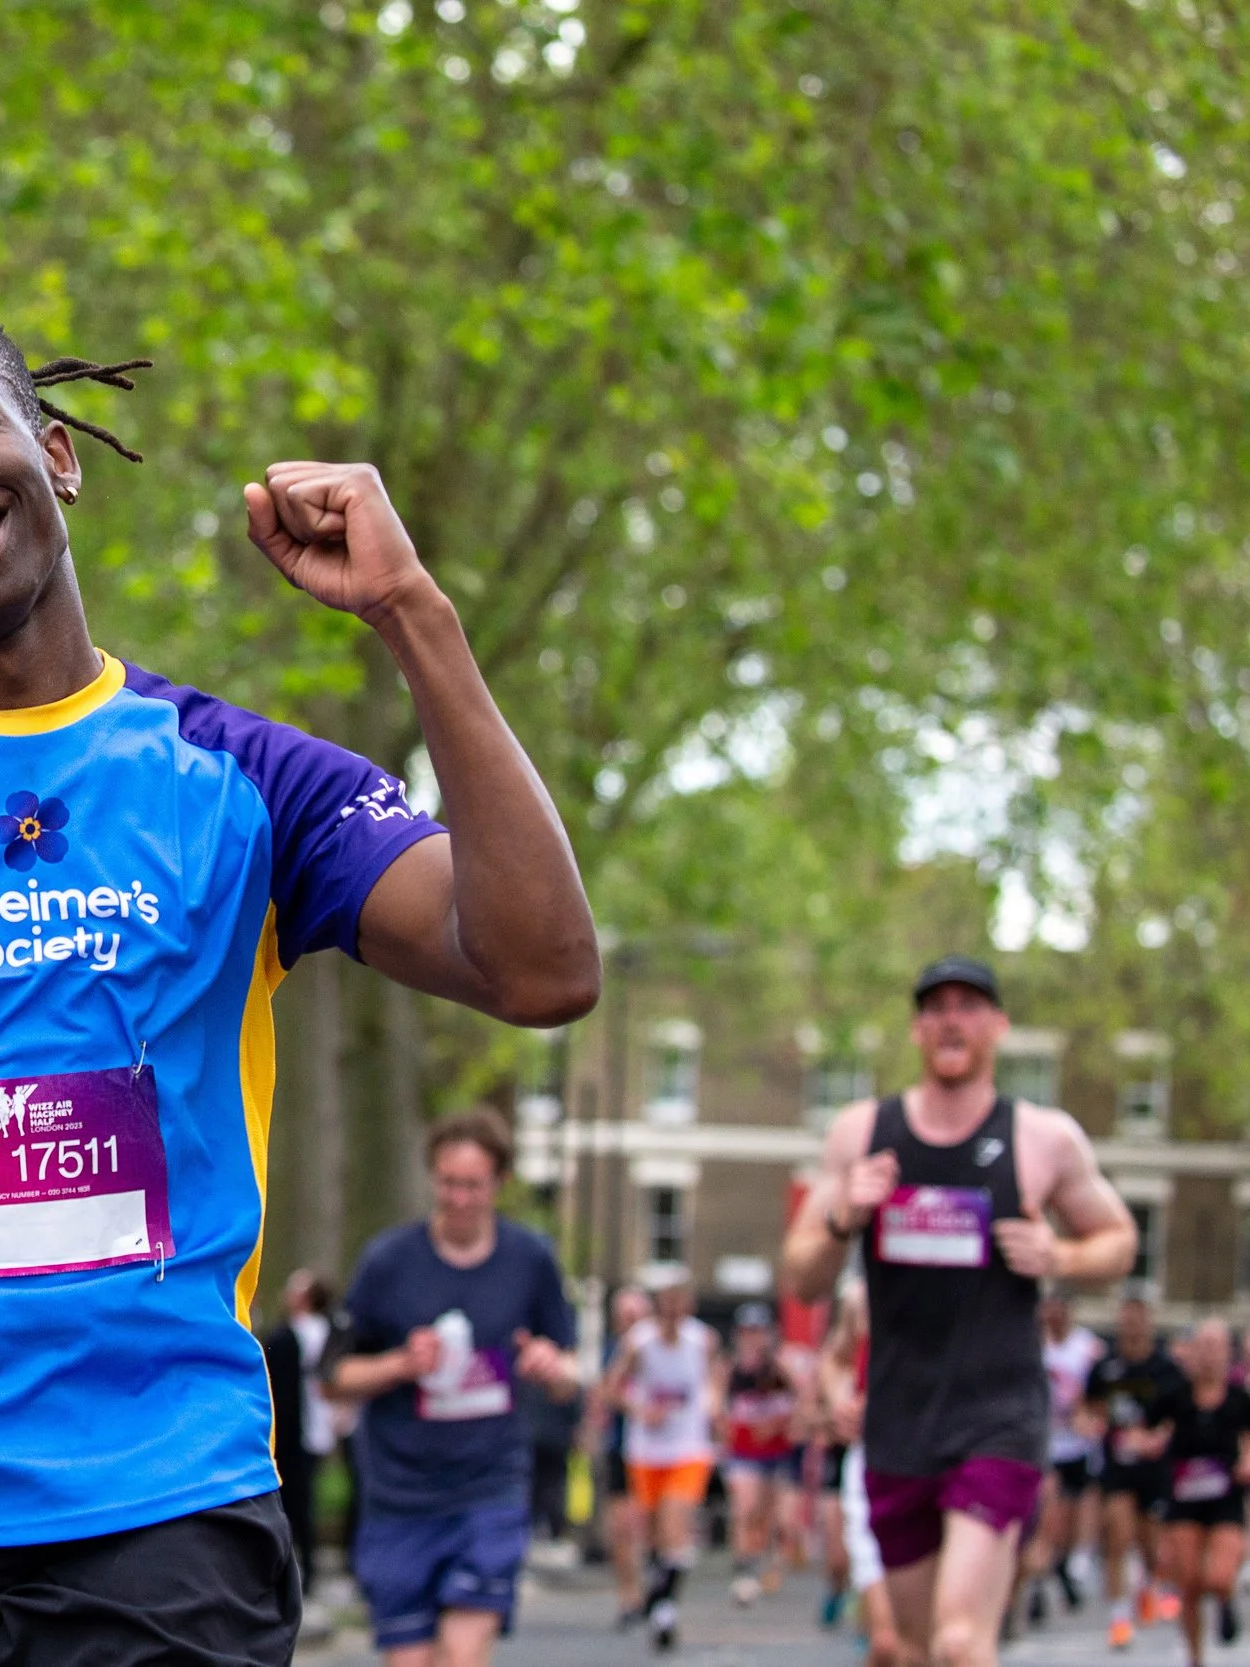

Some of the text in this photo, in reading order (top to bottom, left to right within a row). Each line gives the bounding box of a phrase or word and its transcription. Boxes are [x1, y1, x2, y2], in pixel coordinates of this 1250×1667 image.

[28, 1100, 73, 1112] WIZZ AIR
[30, 1108, 74, 1119] HACKNEY
[30, 1117, 55, 1127] HALF
[30, 1121, 83, 1134] LONDON 2023
[11, 1135, 119, 1183] 17511
[11, 1190, 40, 1199] NUMBER
